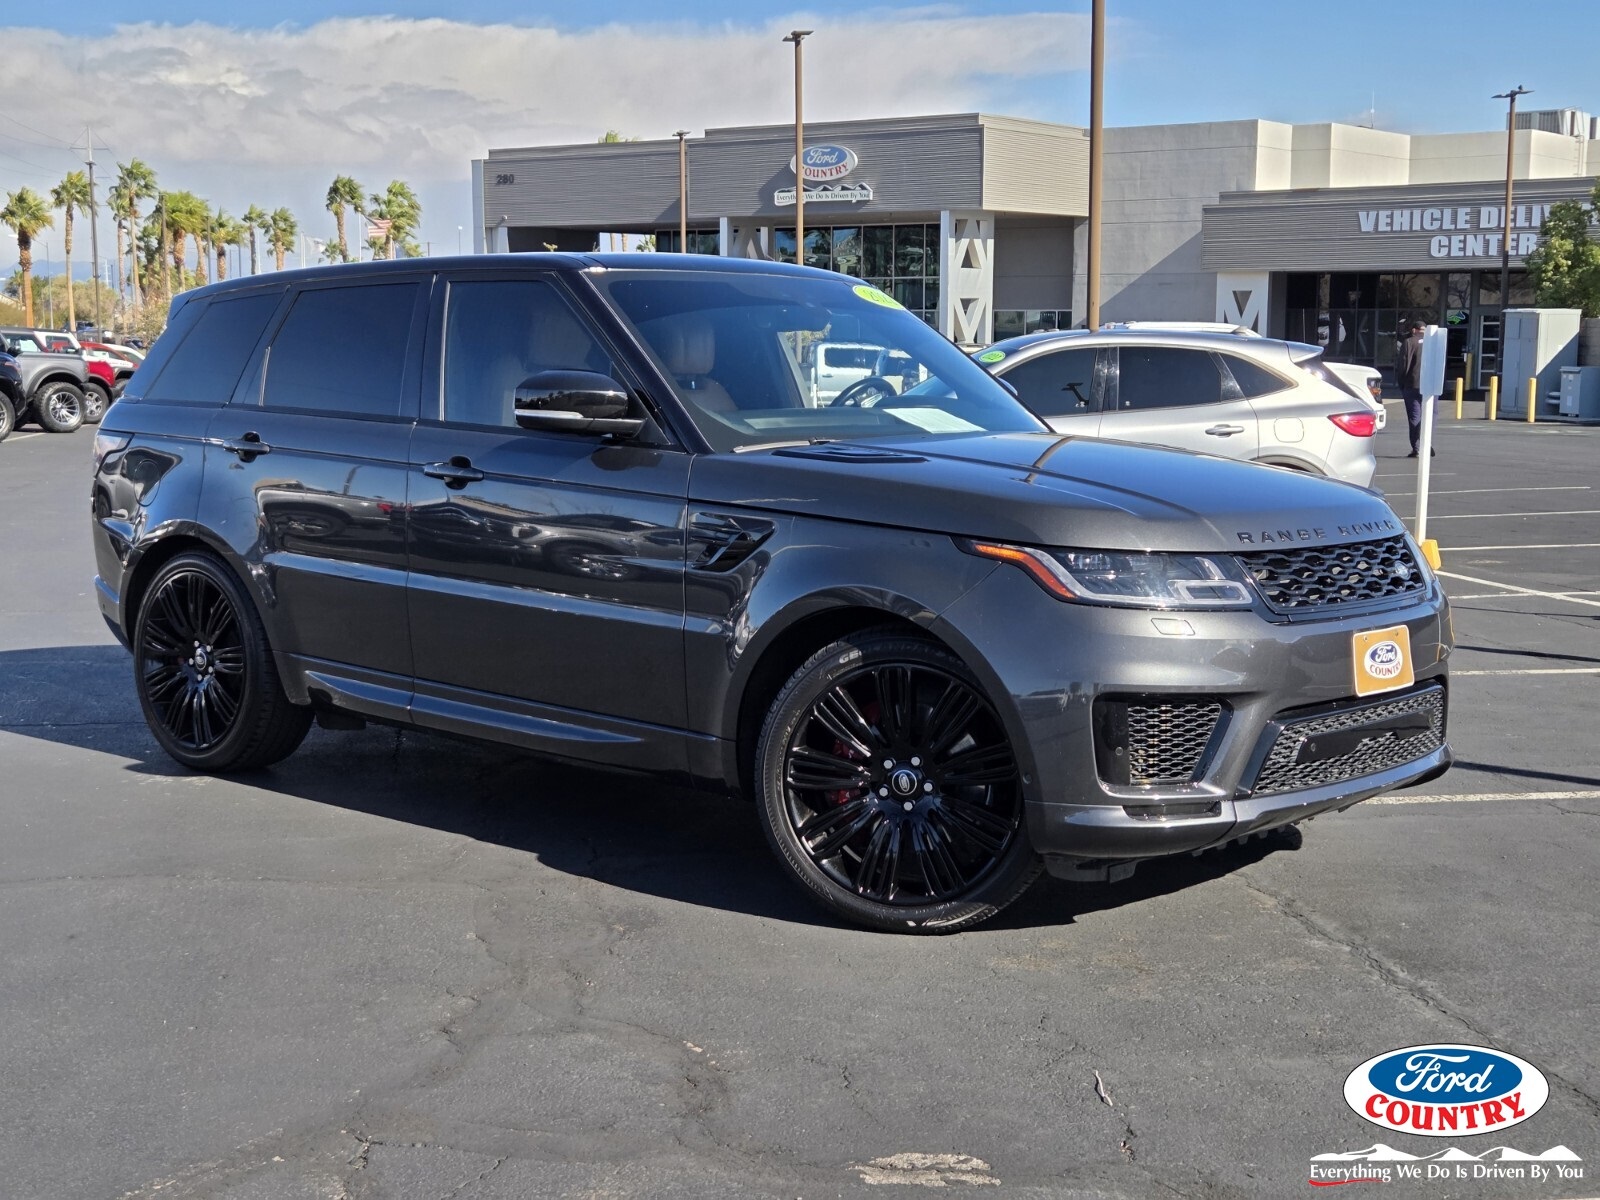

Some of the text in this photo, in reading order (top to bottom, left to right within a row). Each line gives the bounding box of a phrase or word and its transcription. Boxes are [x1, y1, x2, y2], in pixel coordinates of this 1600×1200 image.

[807, 148, 839, 164] Ford
[802, 162, 849, 178] OUNTRY
[496, 174, 514, 185] 280
[831, 191, 849, 199] Driven
[1358, 207, 1471, 232] VEHICLE
[1431, 233, 1537, 258] CENTER
[1237, 519, 1395, 544] RANGE ROVER
[1375, 645, 1397, 662] Ford
